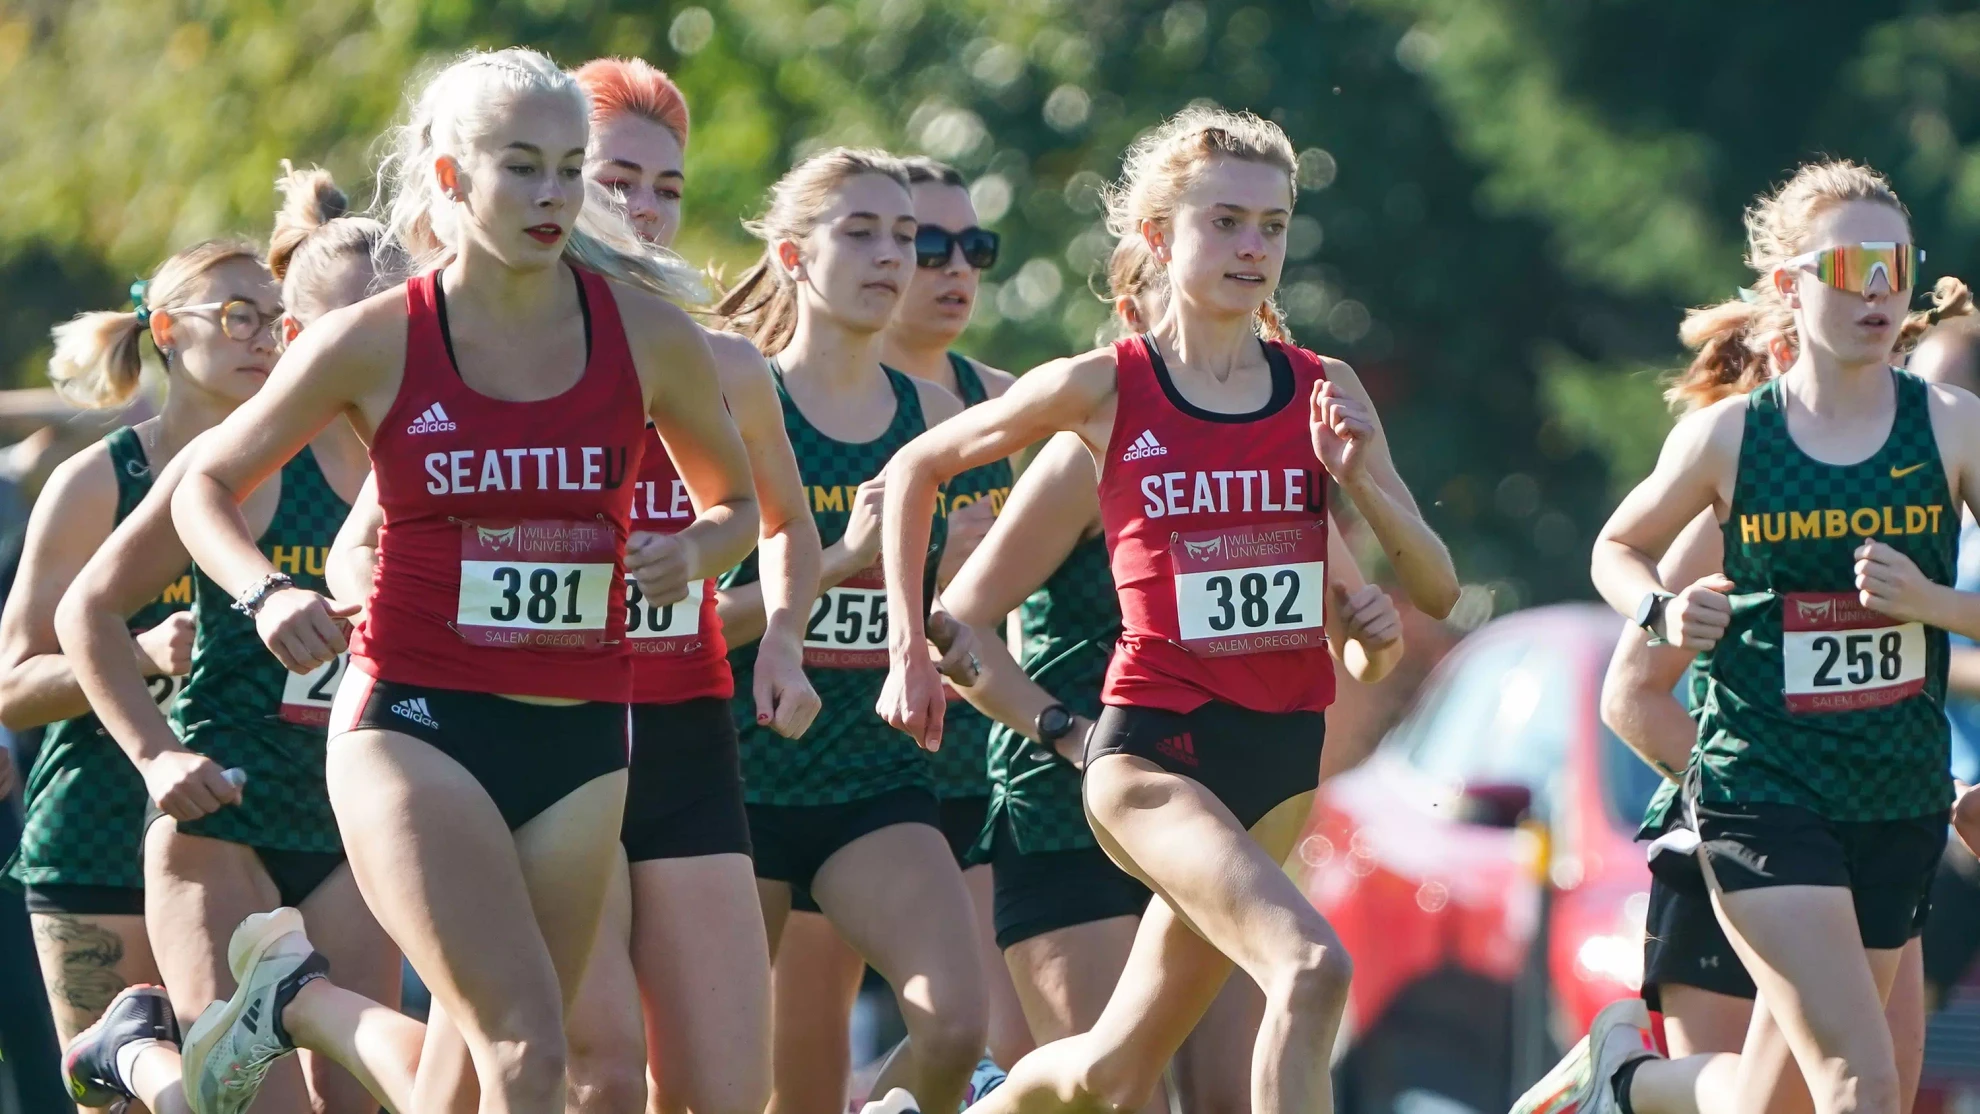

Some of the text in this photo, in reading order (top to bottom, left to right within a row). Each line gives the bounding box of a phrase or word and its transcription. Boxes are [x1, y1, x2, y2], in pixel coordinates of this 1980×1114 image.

[407, 420, 457, 434] adidas
[1123, 445, 1168, 462] adidas
[1740, 504, 1944, 545] HUMBOLDT
[523, 527, 599, 541] WILLAMETTE
[1228, 529, 1303, 546] WILLAMETTE
[523, 539, 592, 552] UNIVERSITY
[1229, 542, 1297, 559] UNIVERSITY
[490, 566, 583, 624] 381
[1205, 569, 1303, 631] 382
[804, 592, 889, 644] 255
[485, 630, 585, 646] SALEM, OREGON
[1208, 633, 1308, 654] SALEM, OREGON
[632, 641, 676, 653] REGON
[1811, 631, 1903, 687] 258
[1859, 686, 1909, 704] OREGON
[391, 704, 439, 730] adidas
